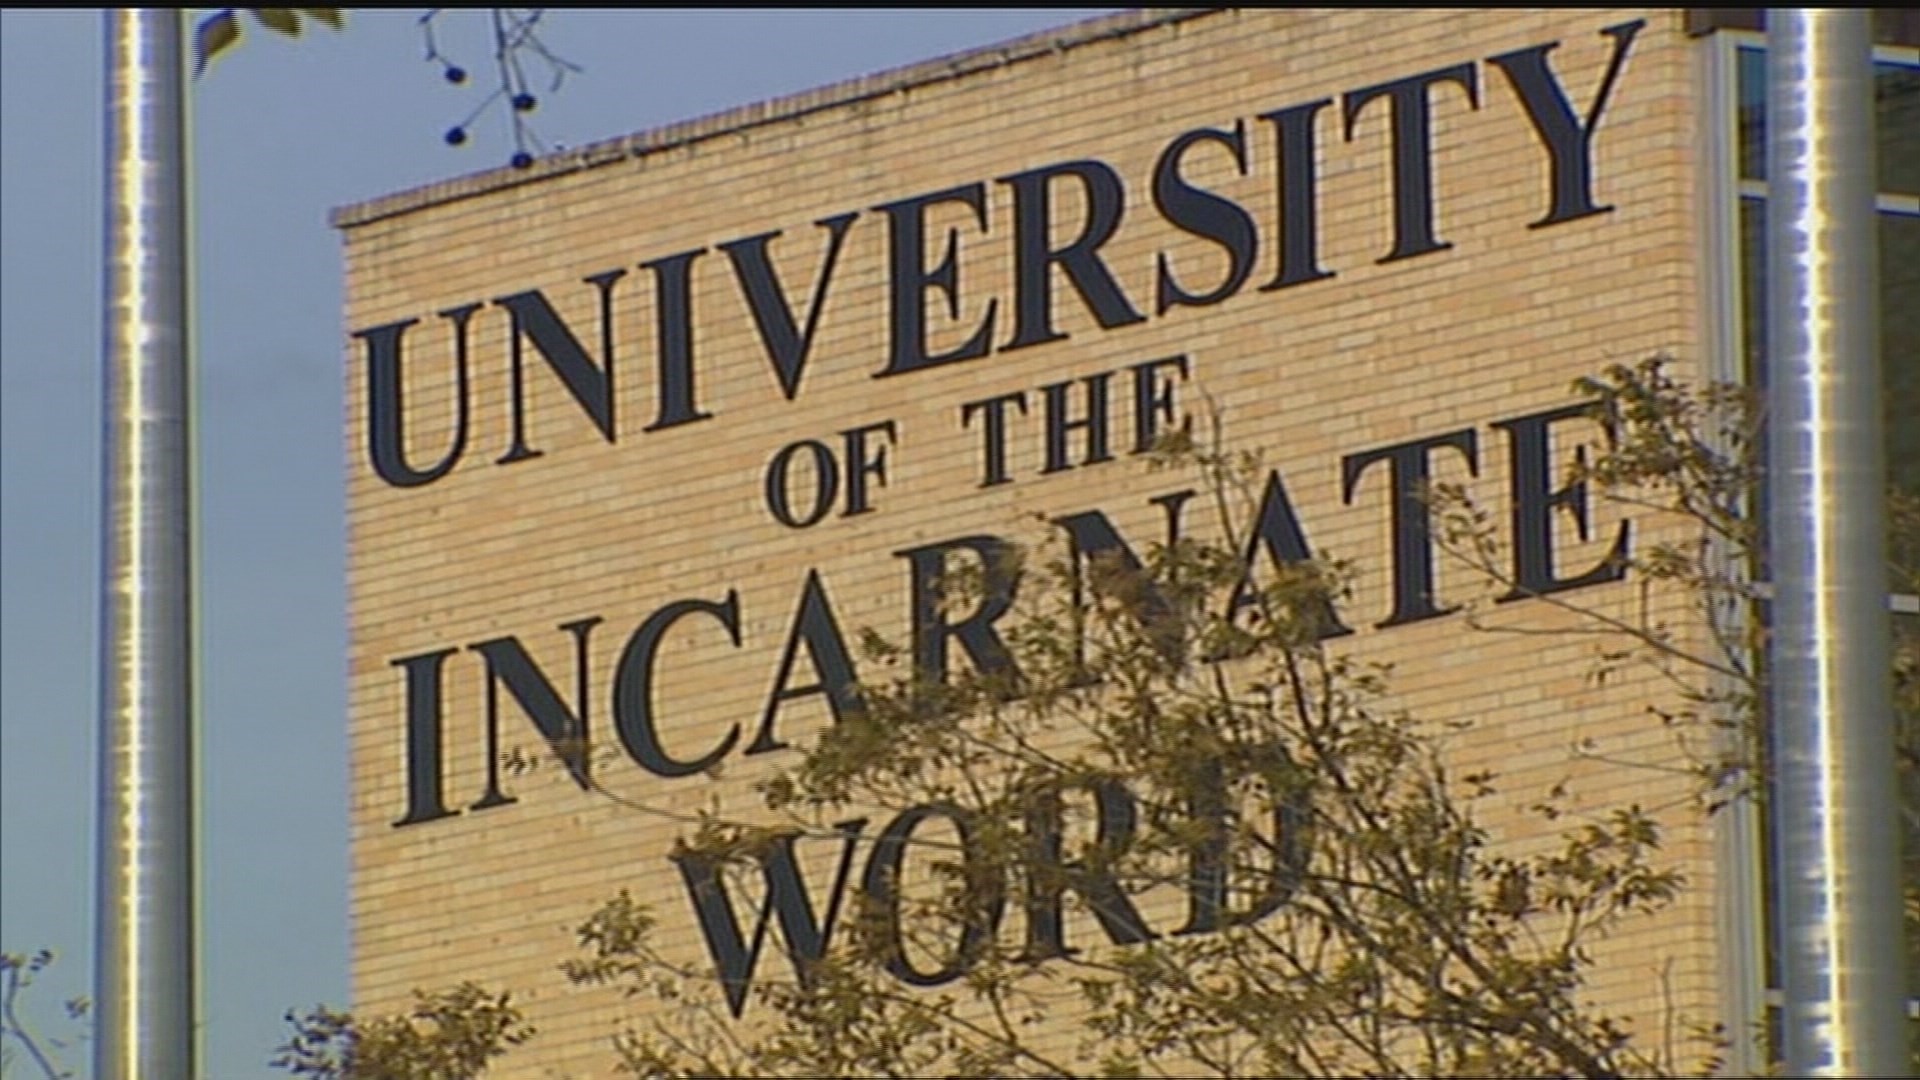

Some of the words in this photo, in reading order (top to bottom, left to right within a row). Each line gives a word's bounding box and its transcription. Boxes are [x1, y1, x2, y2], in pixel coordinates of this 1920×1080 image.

[352, 19, 1646, 488] UNIVERSITY
[390, 402, 1630, 828] INCARNATE
[765, 420, 898, 529] OF
[962, 354, 1192, 487] THE
[668, 745, 1313, 1018] WORD
